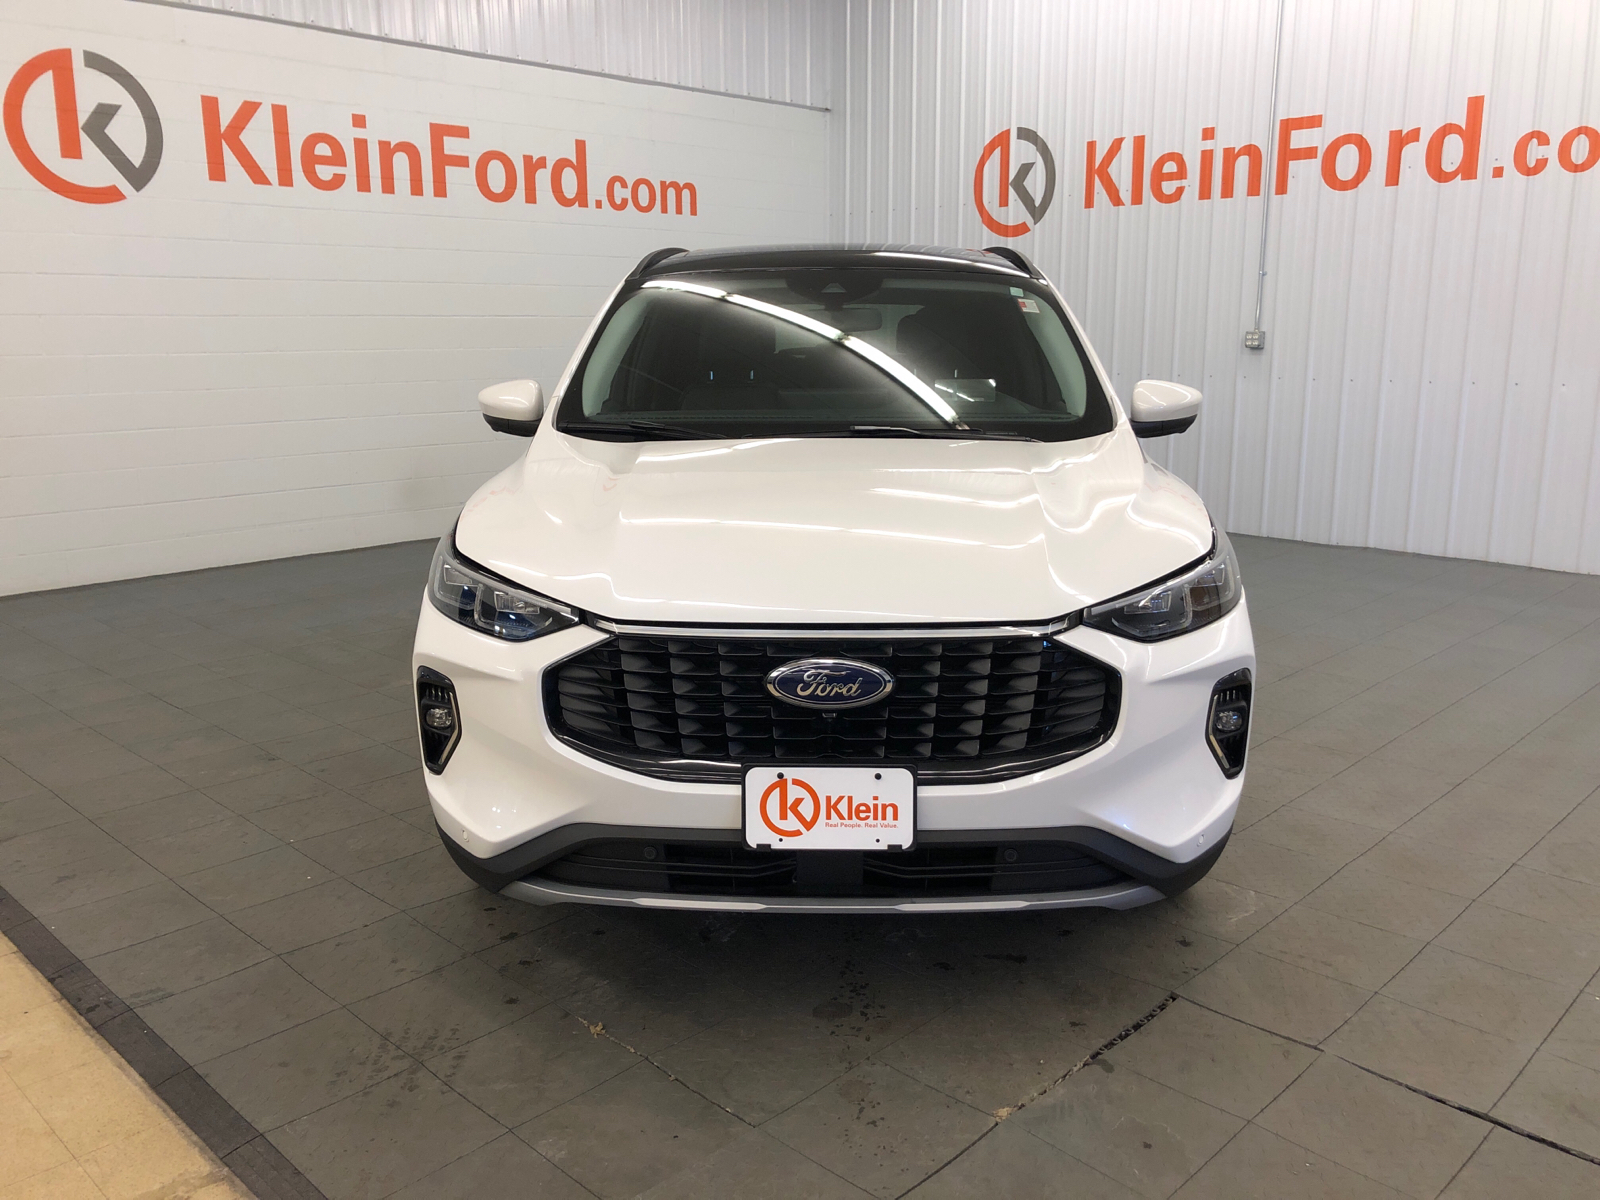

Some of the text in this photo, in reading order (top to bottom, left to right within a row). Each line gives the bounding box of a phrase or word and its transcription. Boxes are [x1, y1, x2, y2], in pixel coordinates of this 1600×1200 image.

[200, 95, 698, 216] KleinFord.com
[1084, 95, 1600, 209] KleinFord.co
[797, 668, 863, 697] Ford
[825, 795, 899, 821] Klein
